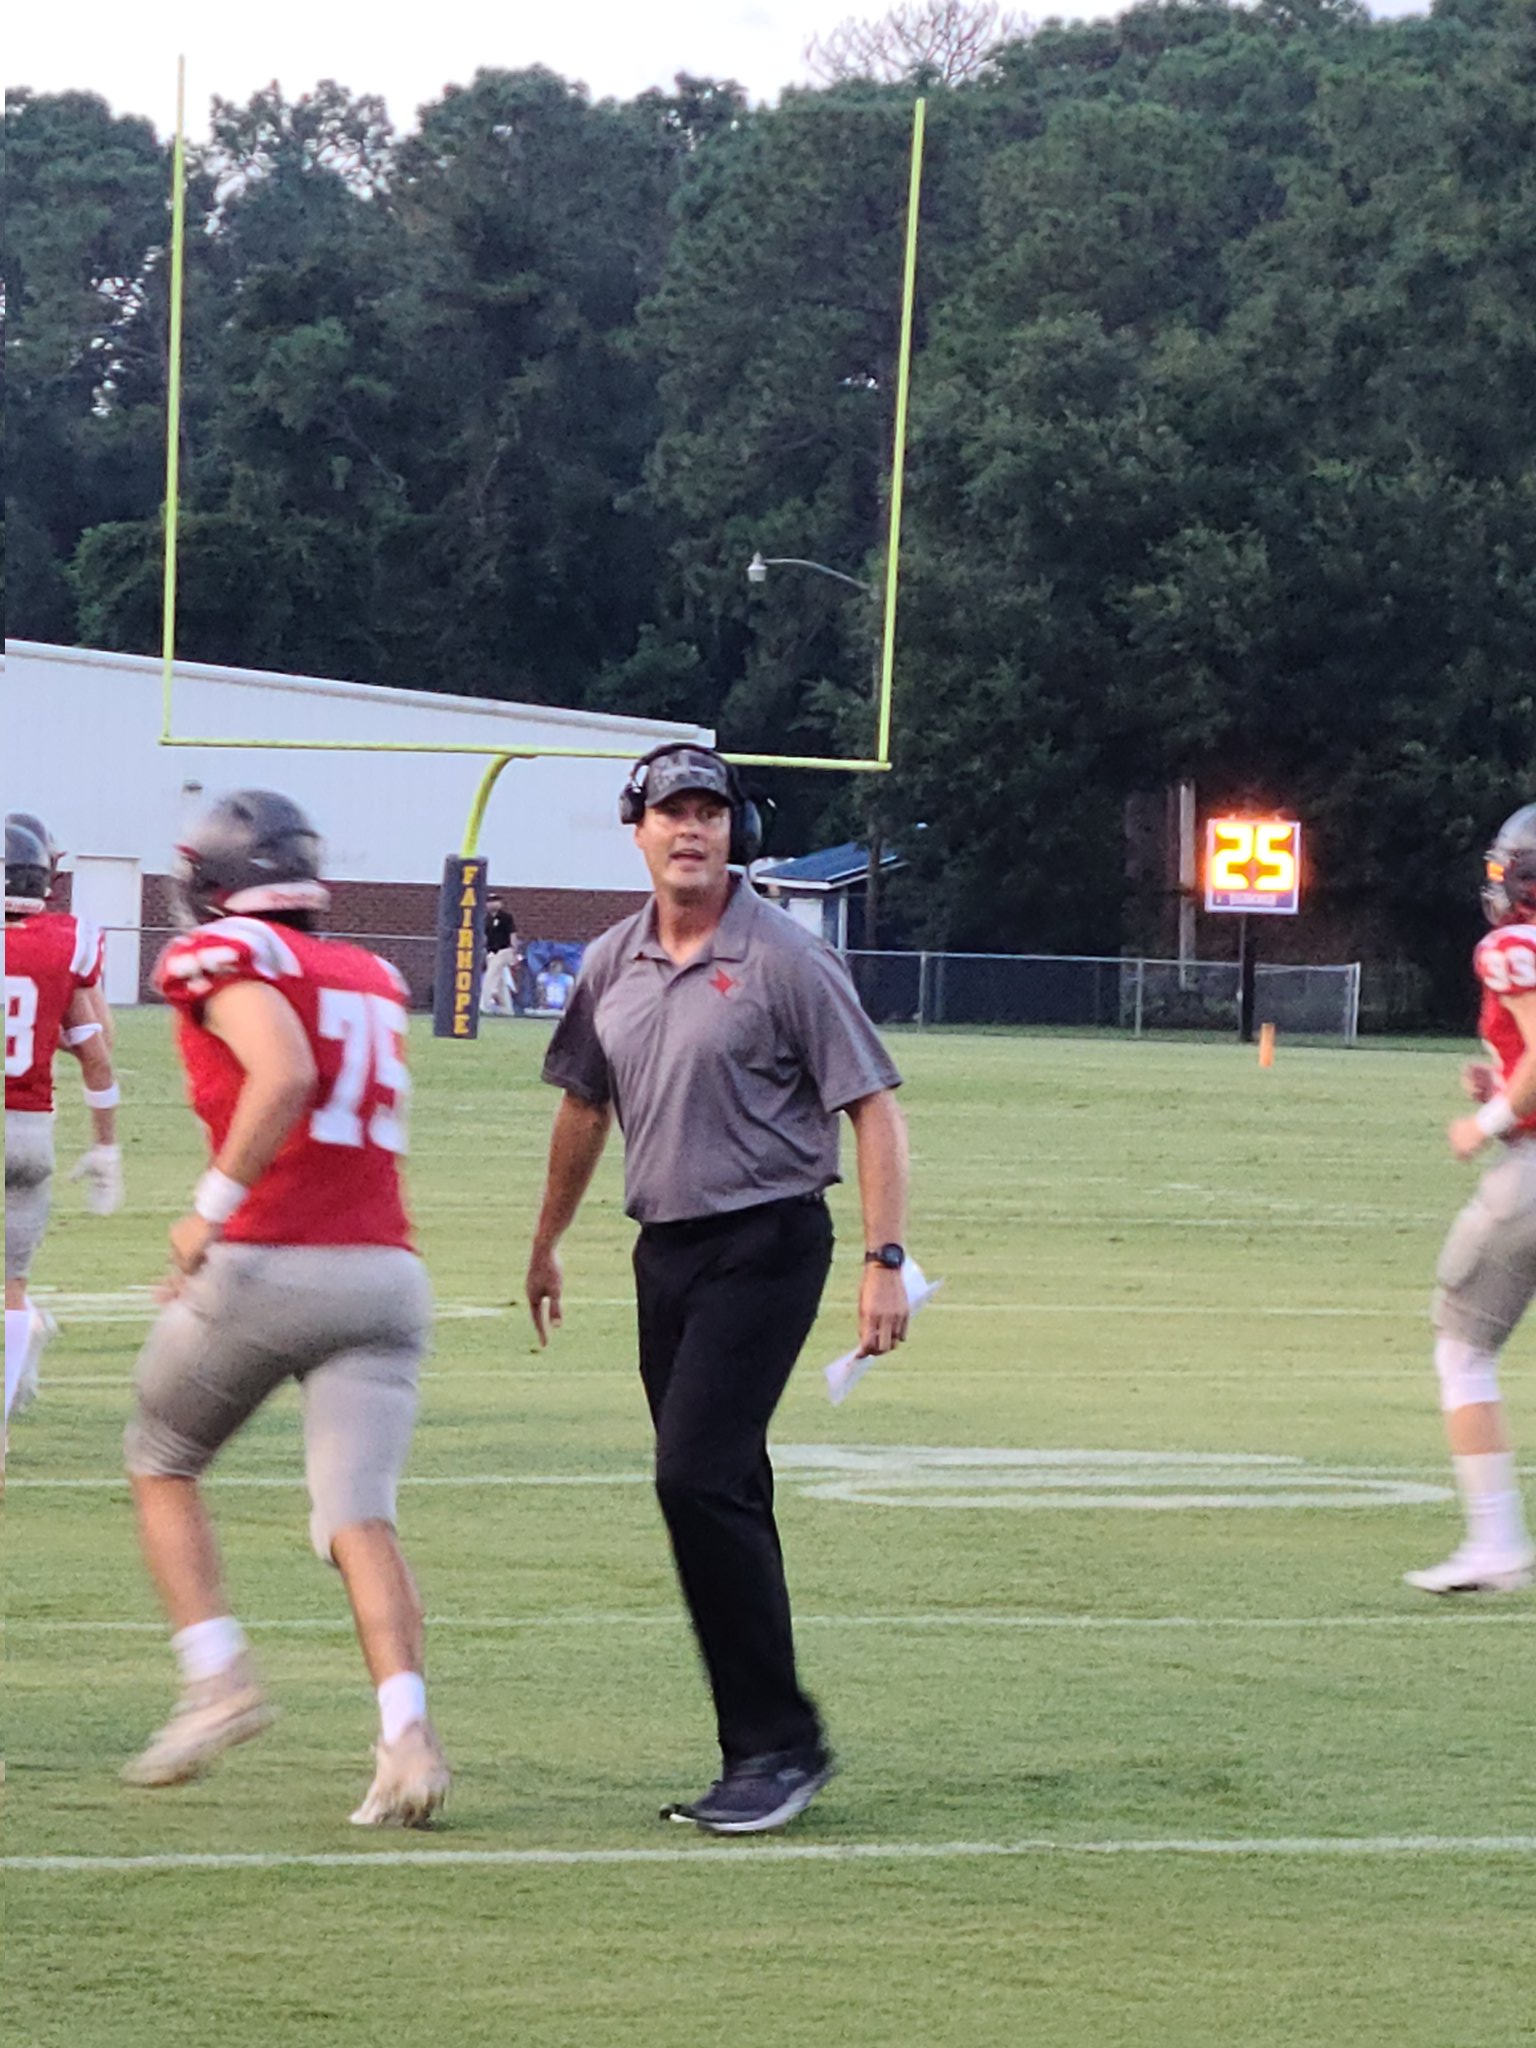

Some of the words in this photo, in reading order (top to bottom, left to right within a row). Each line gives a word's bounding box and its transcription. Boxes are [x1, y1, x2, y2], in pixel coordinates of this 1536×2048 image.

[1212, 823, 1294, 891] 25
[453, 865, 478, 1035] FAIRHOPE
[309, 987, 410, 1154] 75
